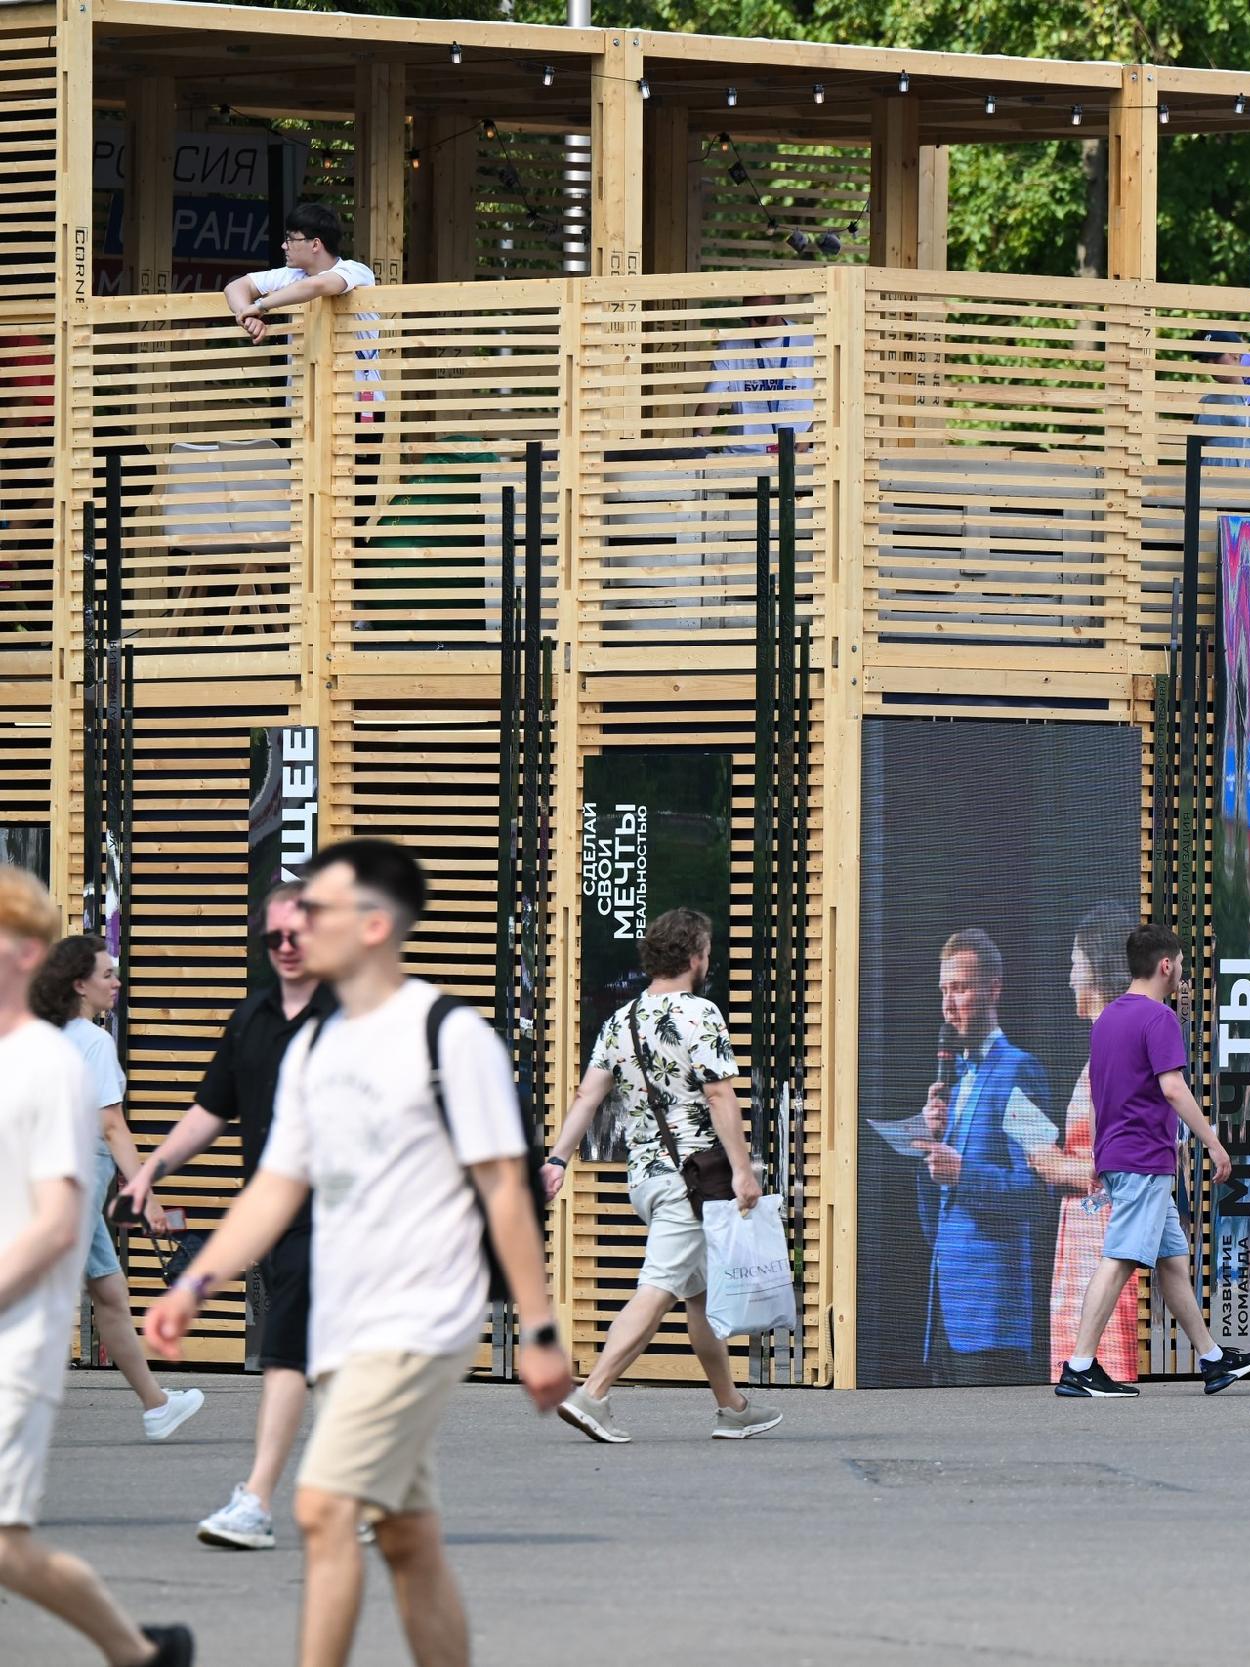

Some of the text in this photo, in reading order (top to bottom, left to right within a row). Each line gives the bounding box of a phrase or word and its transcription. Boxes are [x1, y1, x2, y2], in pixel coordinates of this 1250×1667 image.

[95, 141, 258, 186] РСИЯ
[583, 802, 598, 896] СДЕЛАЙ
[598, 839, 612, 916] СВОИ
[613, 804, 636, 939] МЕЧТЫ
[635, 805, 647, 939] РЕАЛЬНОСТЬЮ
[1181, 812, 1191, 912] РЕАЛИЗАЦИЯ
[1181, 978, 1190, 1025] УСПЕХ
[1222, 1235, 1232, 1337] РАЗВИТИЕ
[1237, 1237, 1250, 1337] КОМАНДА
